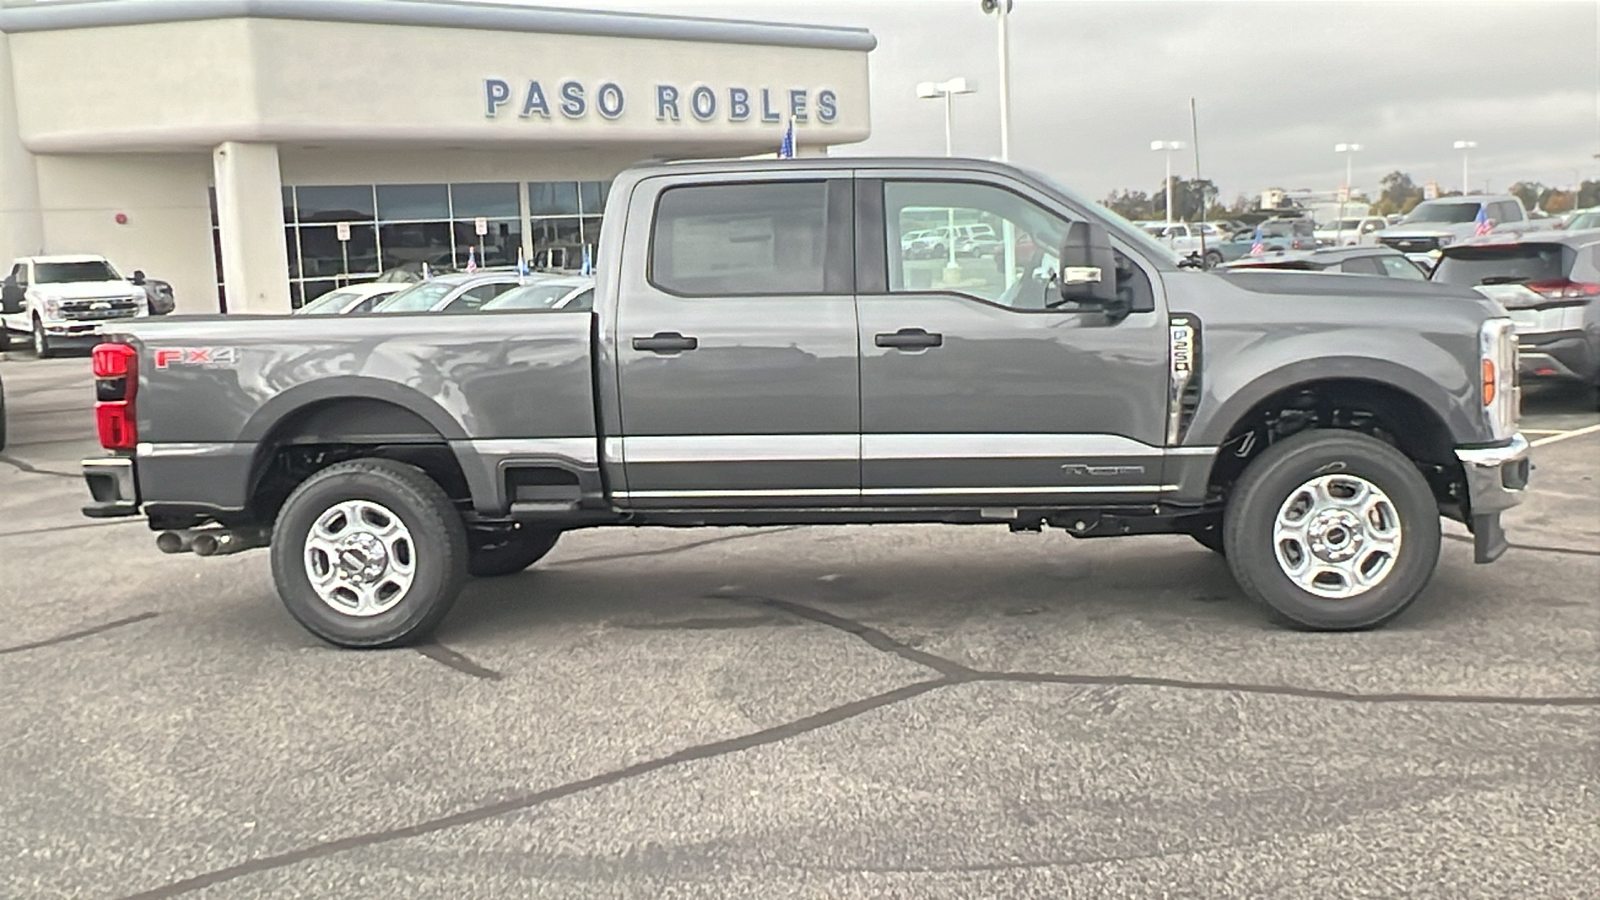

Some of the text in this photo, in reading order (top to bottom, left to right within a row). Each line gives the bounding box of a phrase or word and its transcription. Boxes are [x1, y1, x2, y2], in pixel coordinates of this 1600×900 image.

[484, 78, 838, 123] PASO ROBLES
[155, 347, 237, 368] FX4
